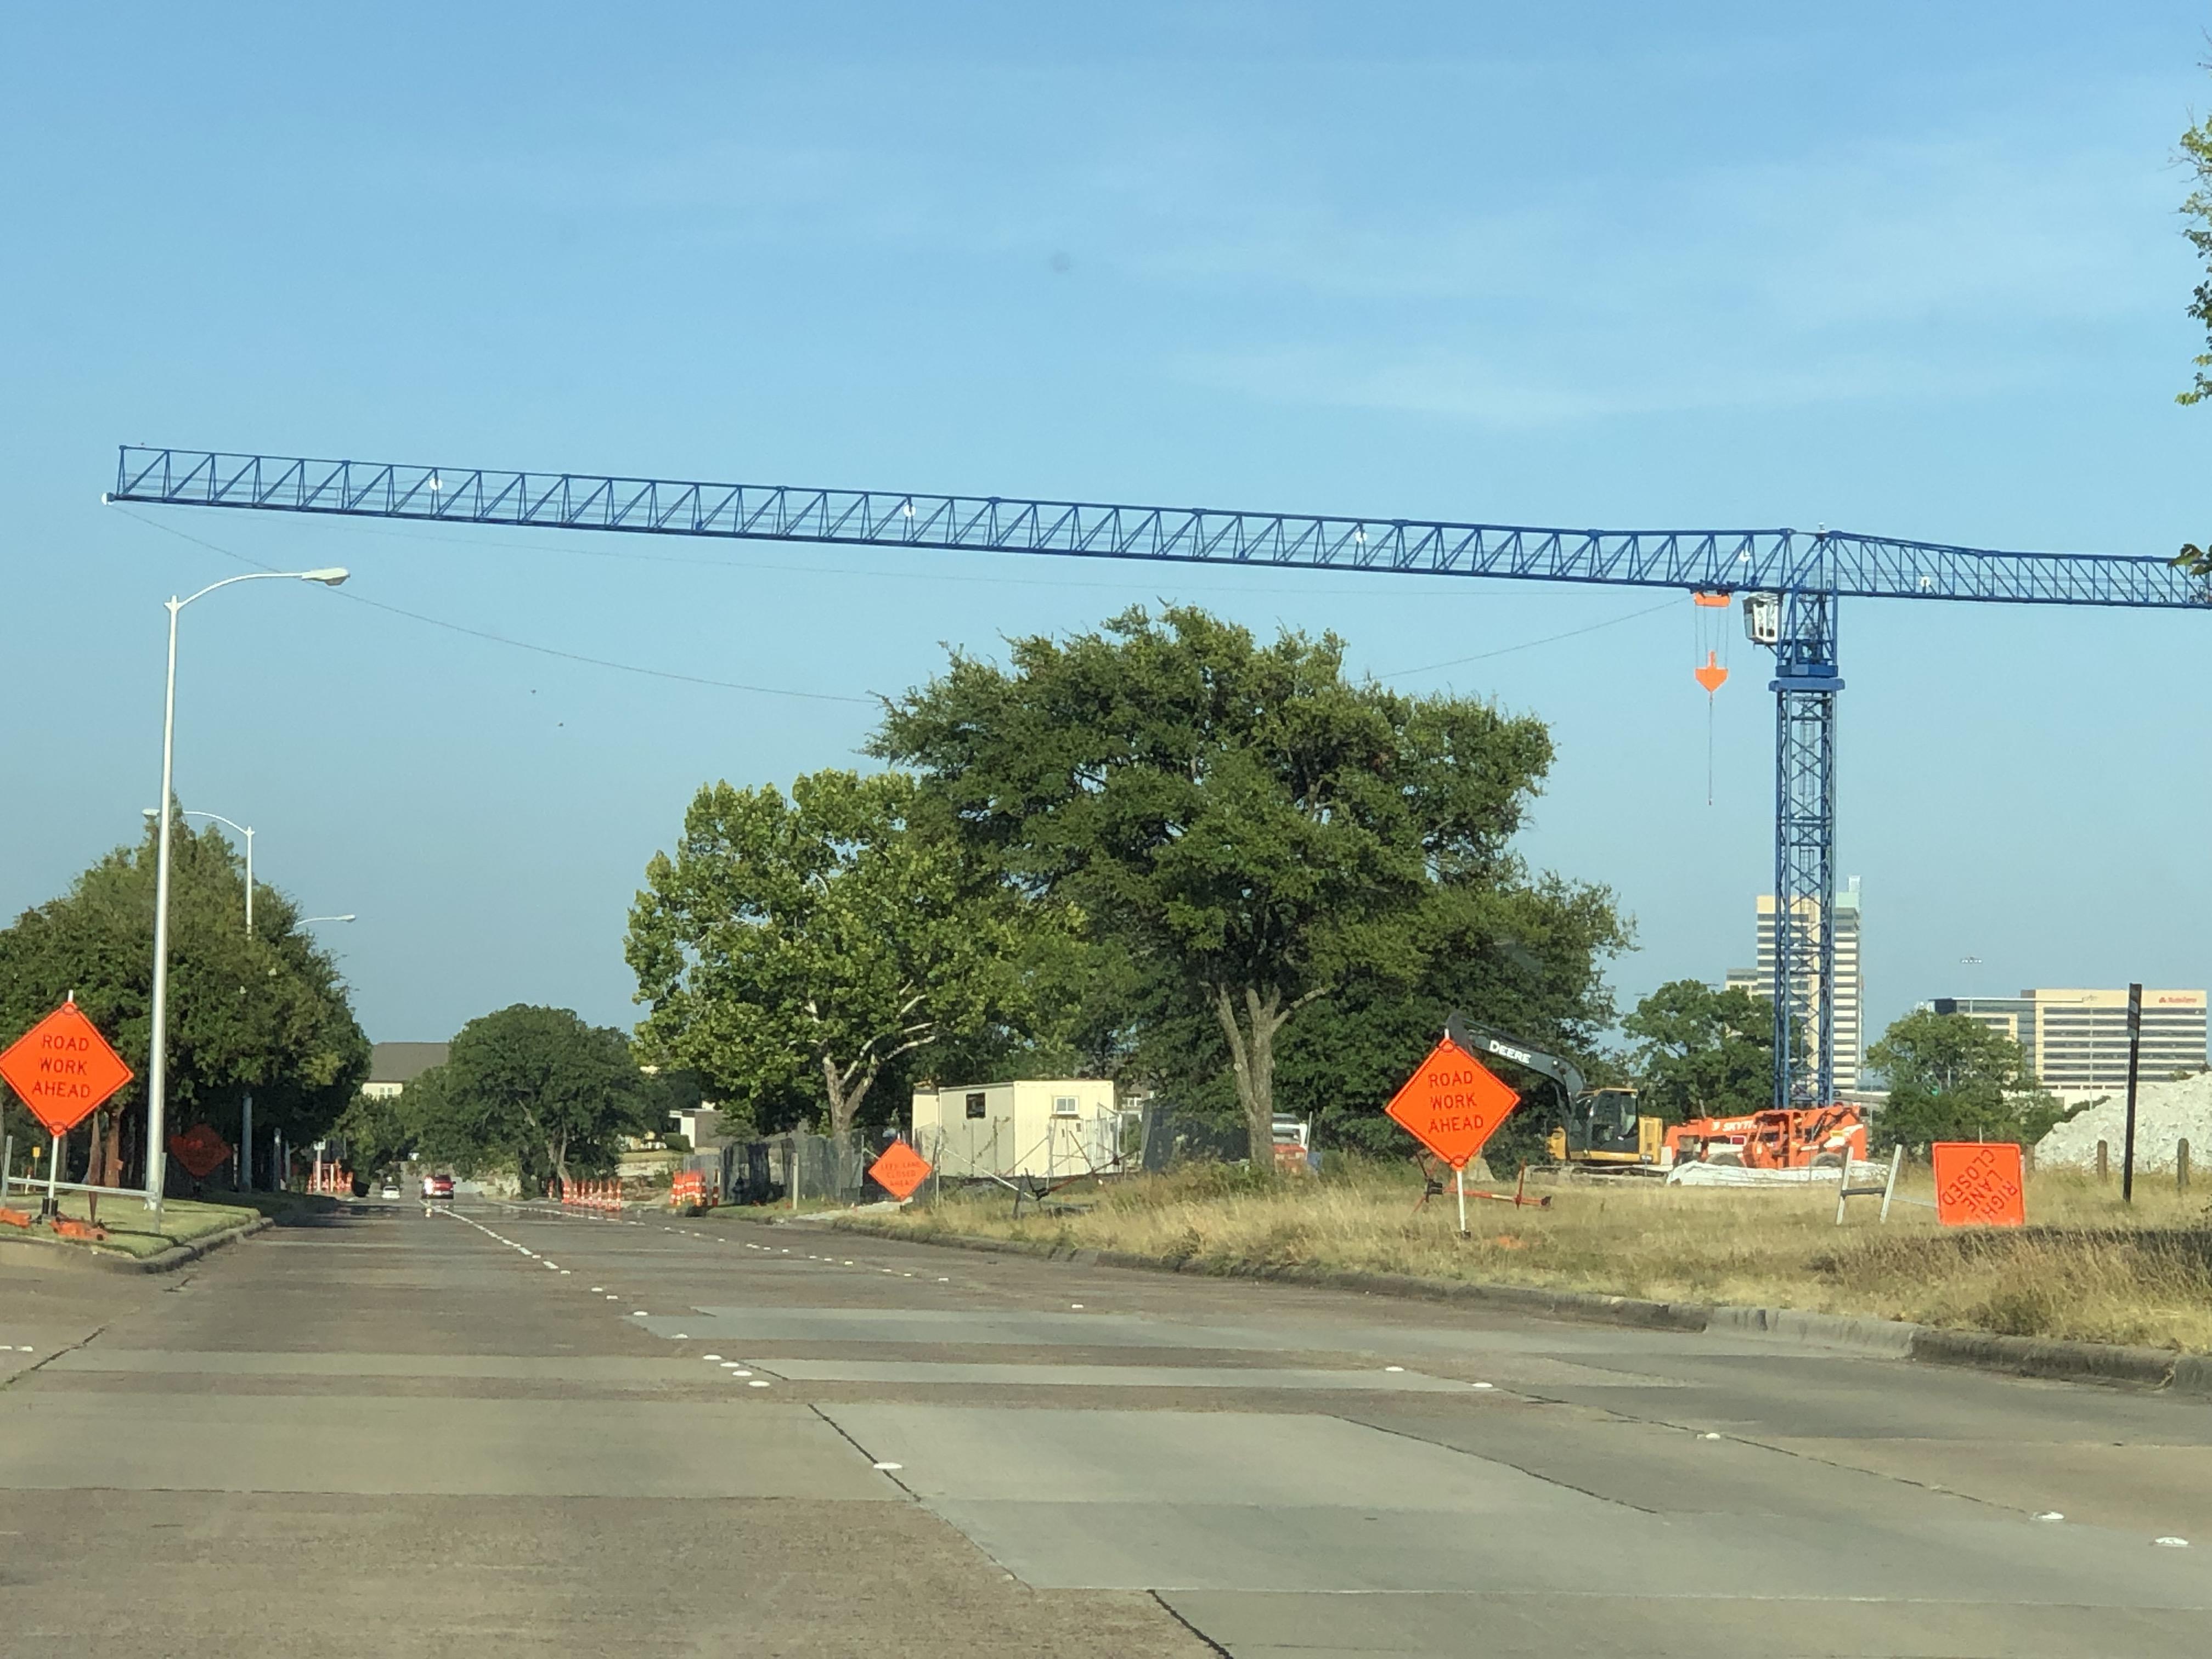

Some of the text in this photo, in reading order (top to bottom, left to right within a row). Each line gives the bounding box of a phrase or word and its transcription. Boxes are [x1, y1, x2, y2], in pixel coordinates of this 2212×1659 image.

[41, 1034, 89, 1052] ROAD
[1489, 1039, 1532, 1064] DEERE
[39, 1057, 88, 1076] WORK
[1428, 1070, 1473, 1088] ROAD
[32, 1080, 91, 1098] AHEAD
[1430, 1092, 1477, 1111] WORK
[1428, 1114, 1484, 1135] AHEAD
[1942, 1149, 1996, 1205] CLOSED
[1961, 1170, 2003, 1213] LANE
